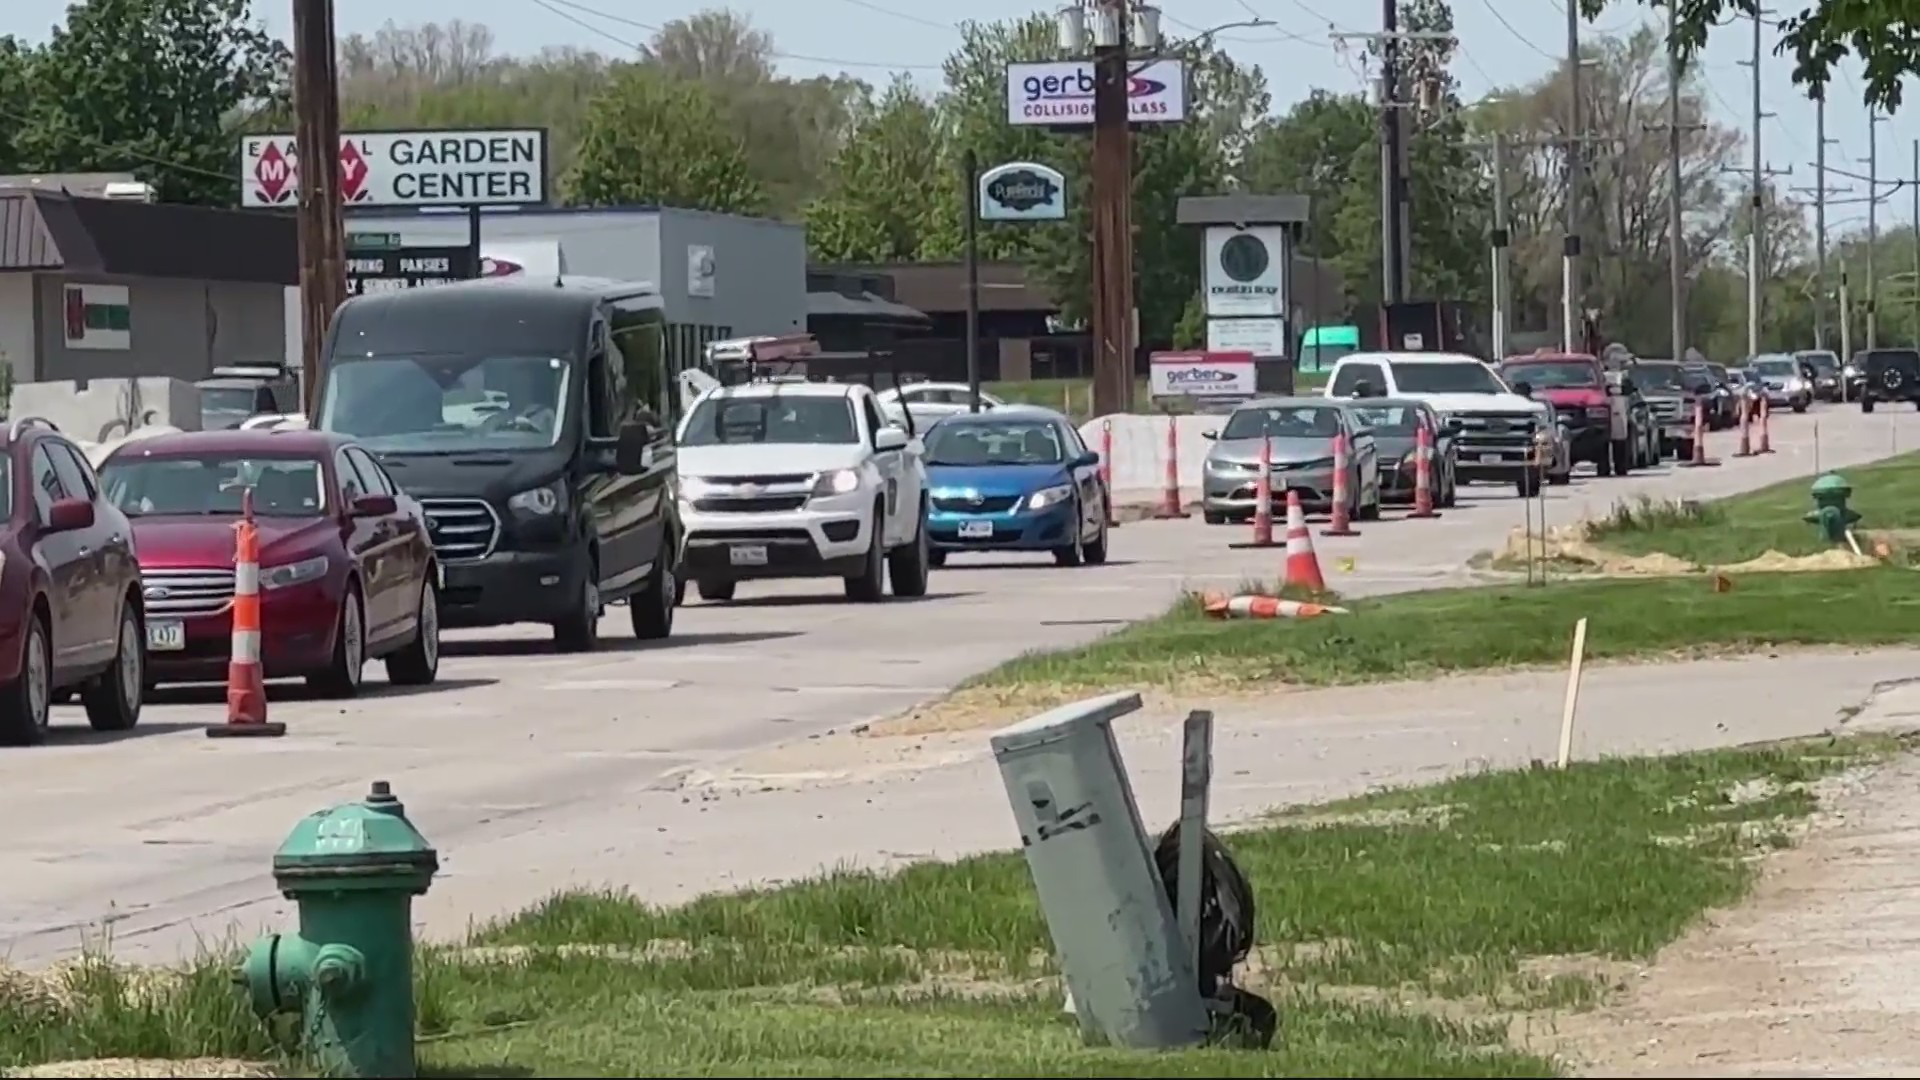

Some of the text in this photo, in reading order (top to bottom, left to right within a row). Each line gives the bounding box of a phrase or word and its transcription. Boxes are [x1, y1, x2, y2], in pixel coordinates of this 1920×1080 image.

[1023, 68, 1095, 100] gerb
[1130, 102, 1168, 115] LASS
[389, 137, 534, 165] GARDEN
[392, 171, 531, 199] CENTER
